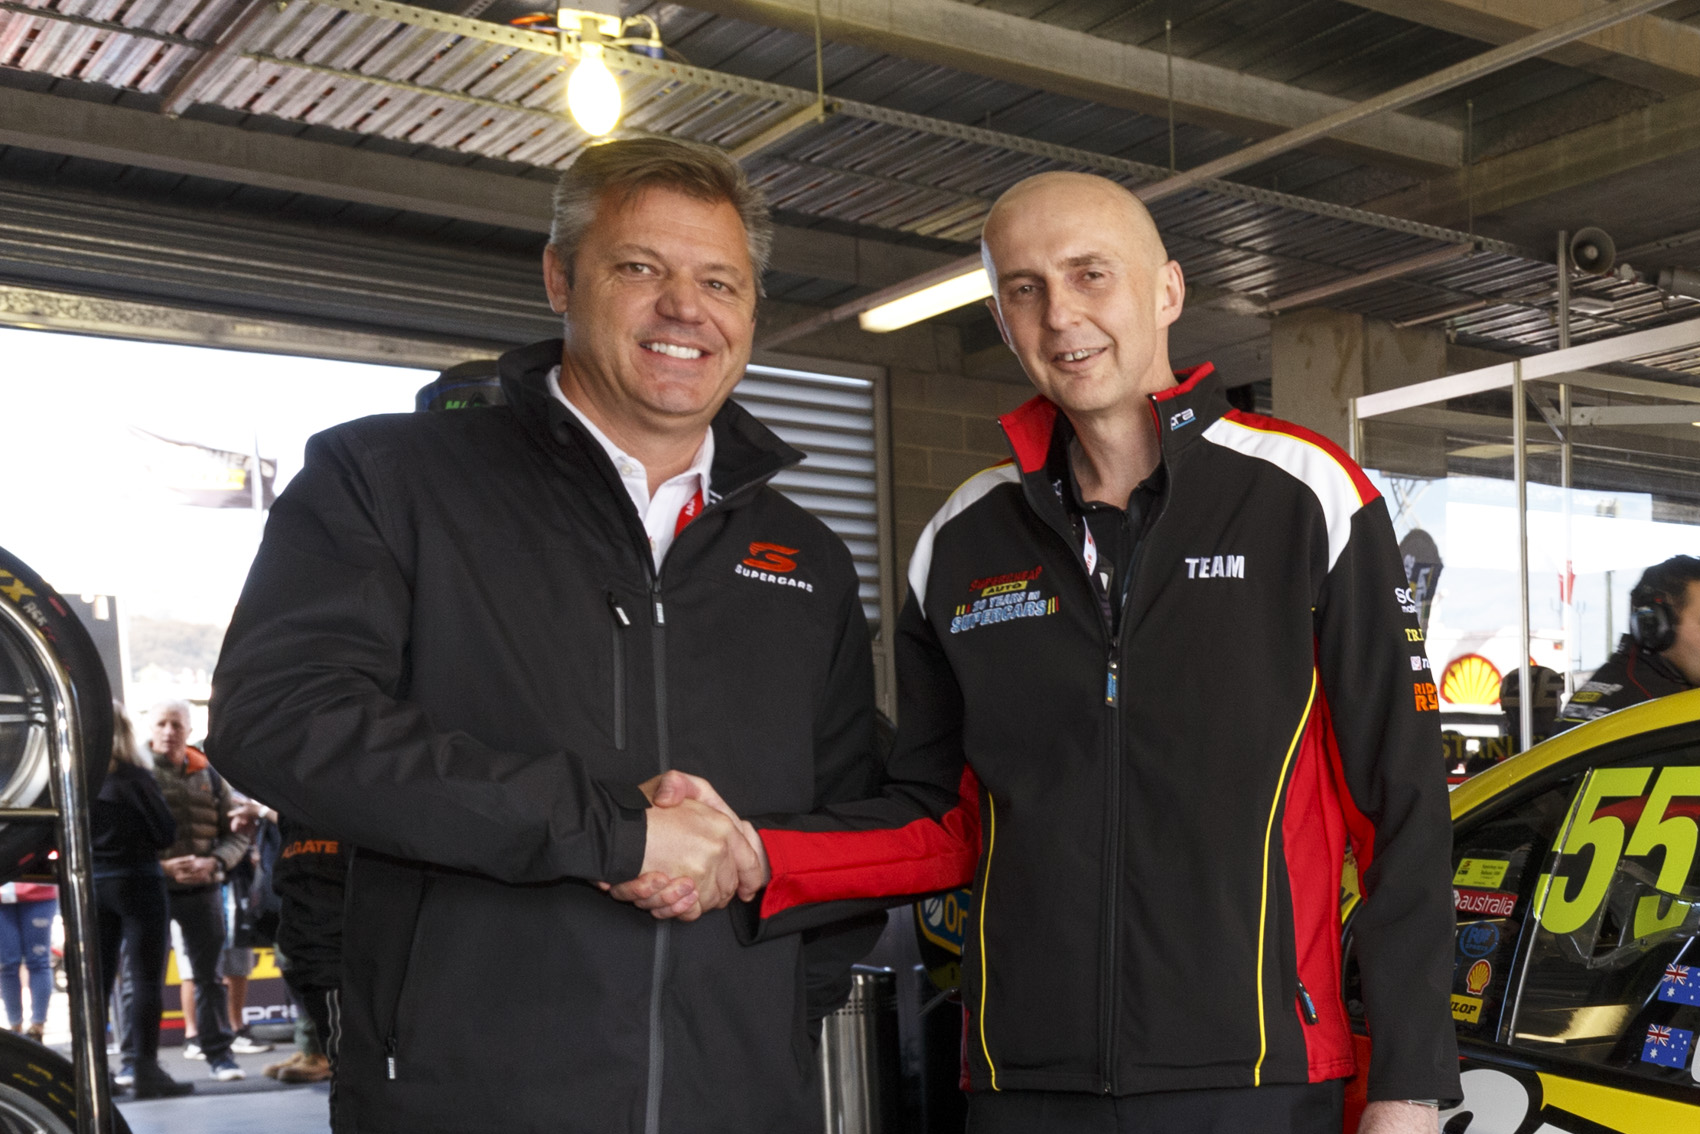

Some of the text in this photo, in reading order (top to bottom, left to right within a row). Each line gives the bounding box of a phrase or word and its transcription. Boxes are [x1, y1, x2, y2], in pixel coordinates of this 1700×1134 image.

[734, 563, 814, 593] SUPERCARS
[1185, 555, 1245, 580] TEAM
[950, 600, 1047, 634] SUPERCARS
[1459, 893, 1515, 916] australia
